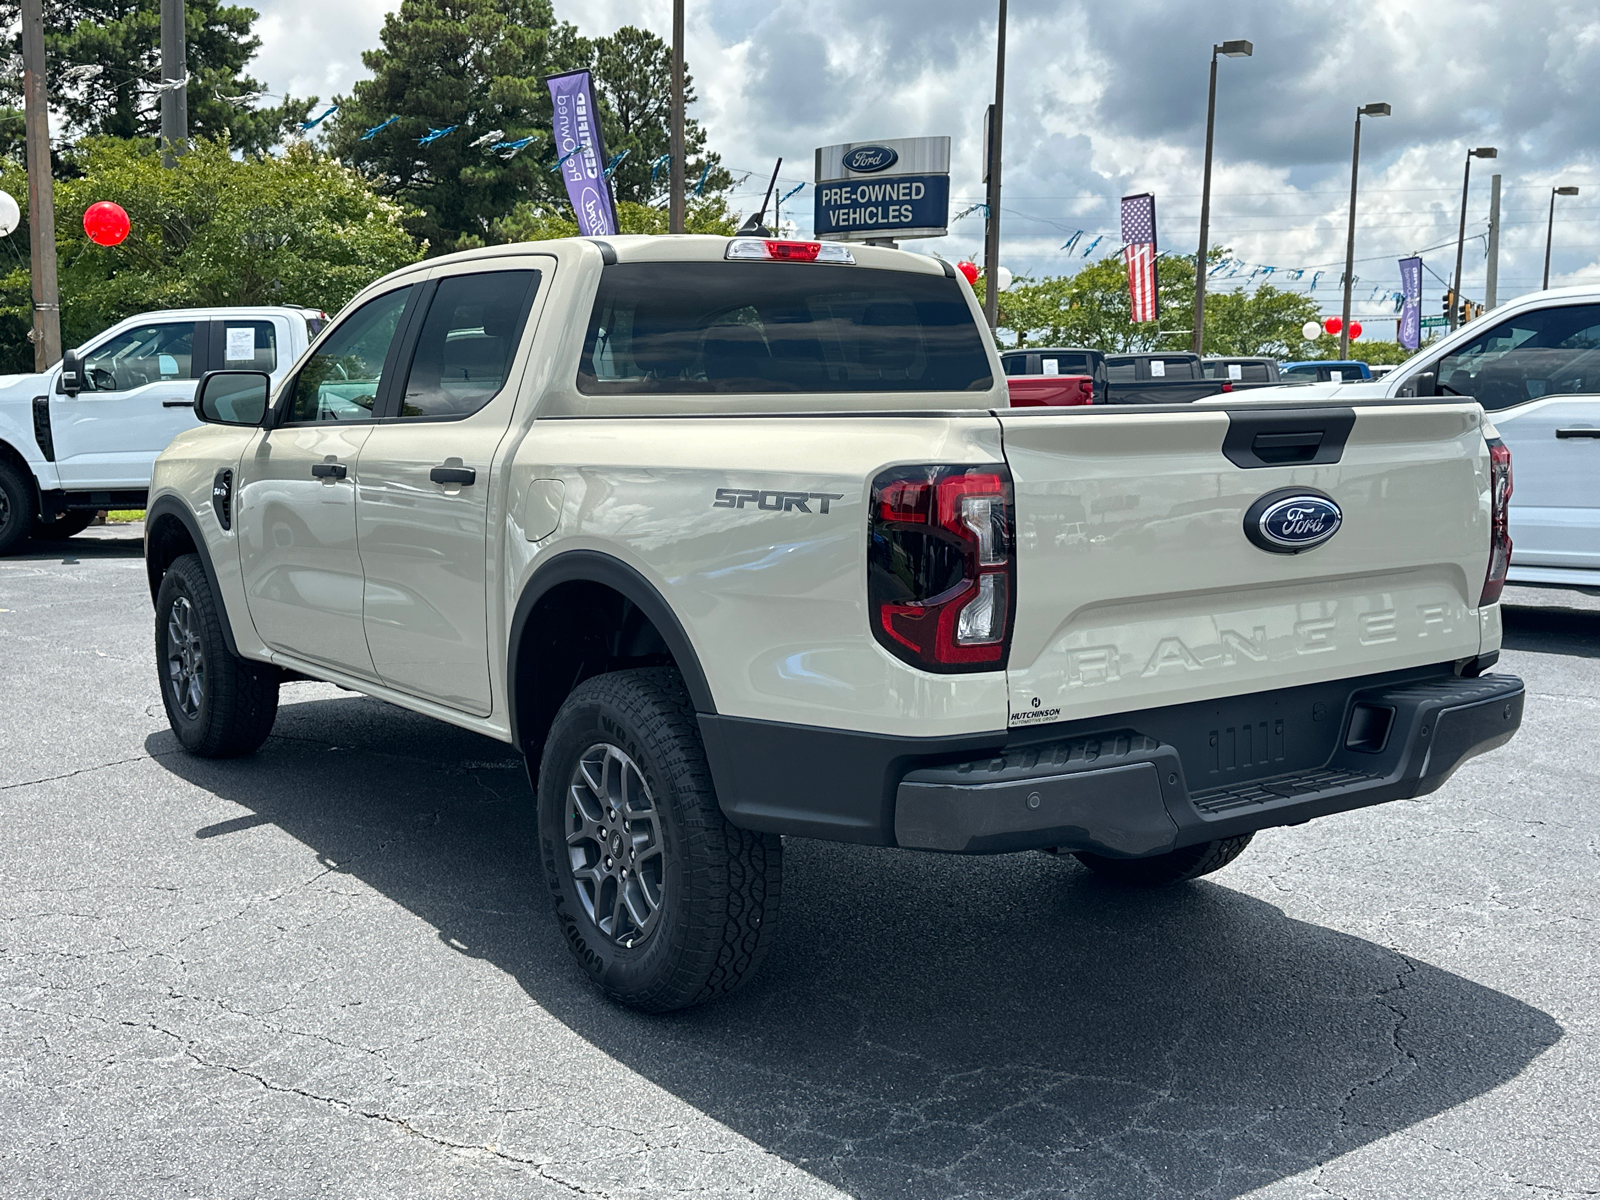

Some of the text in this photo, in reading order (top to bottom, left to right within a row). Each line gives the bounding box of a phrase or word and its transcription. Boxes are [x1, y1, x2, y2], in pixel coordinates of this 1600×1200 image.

[852, 150, 882, 167] Ford
[822, 182, 925, 207] PRE-OWNED
[829, 204, 913, 227] VEHICLES
[703, 488, 845, 514] SPORT
[1281, 507, 1326, 535] Ford
[1066, 602, 1453, 687] RANGER
[1011, 708, 1061, 720] HUTCHINSON
